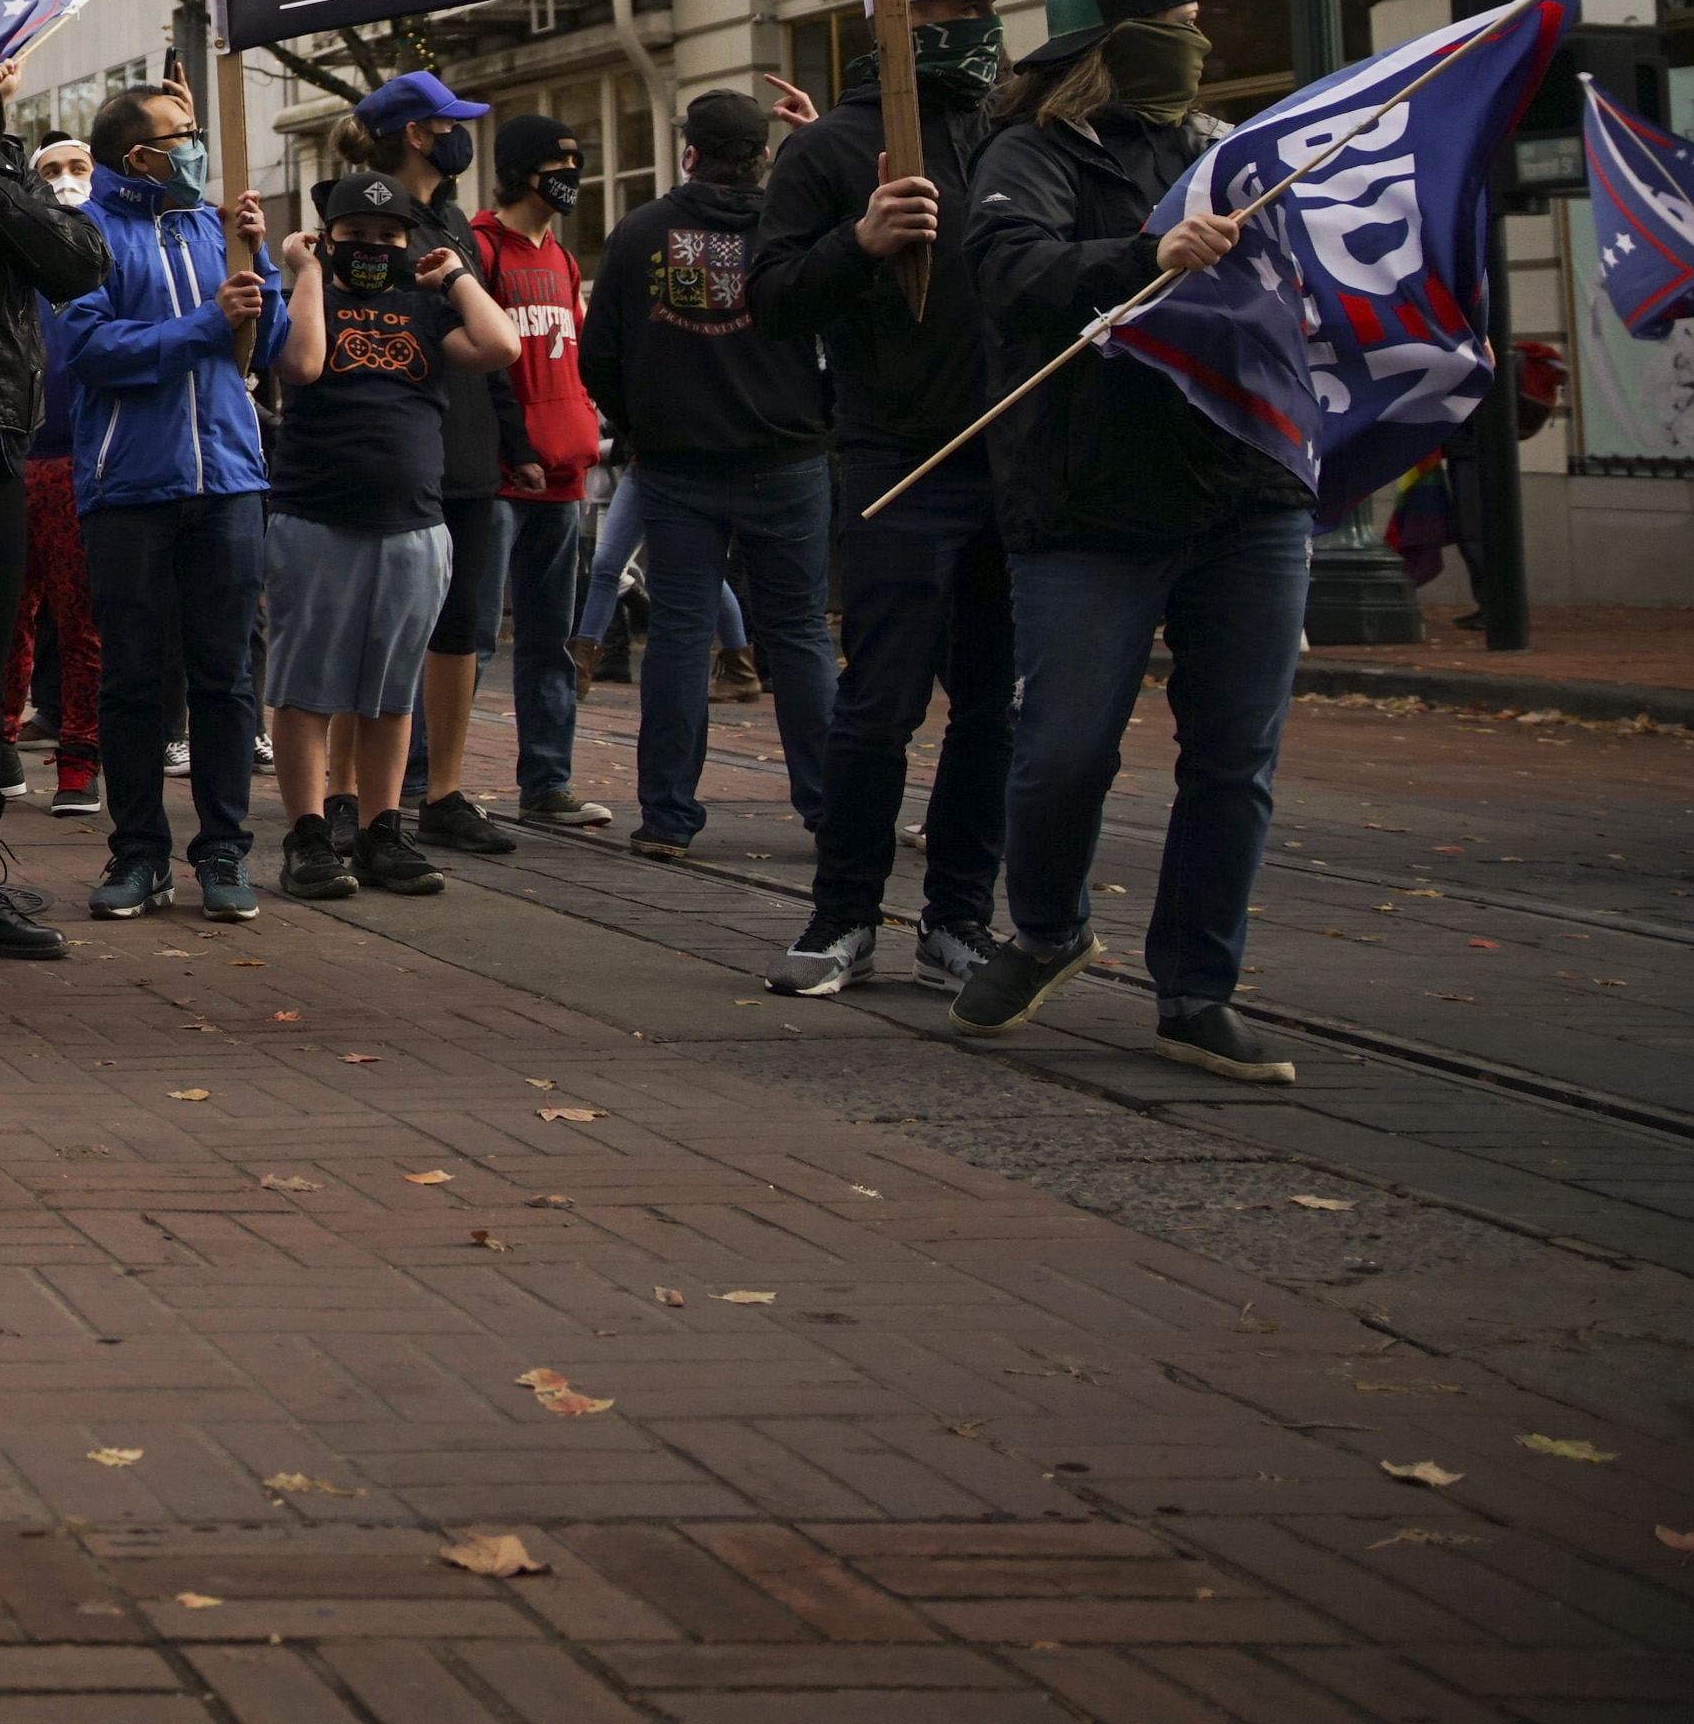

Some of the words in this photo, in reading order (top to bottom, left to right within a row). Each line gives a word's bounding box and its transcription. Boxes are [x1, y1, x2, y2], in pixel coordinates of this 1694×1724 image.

[120, 187, 142, 202] HH
[352, 251, 390, 263] GAMER
[351, 260, 388, 271] GAMER
[350, 269, 388, 281] GAMER
[336, 308, 379, 322] OUT
[382, 312, 411, 327] OF
